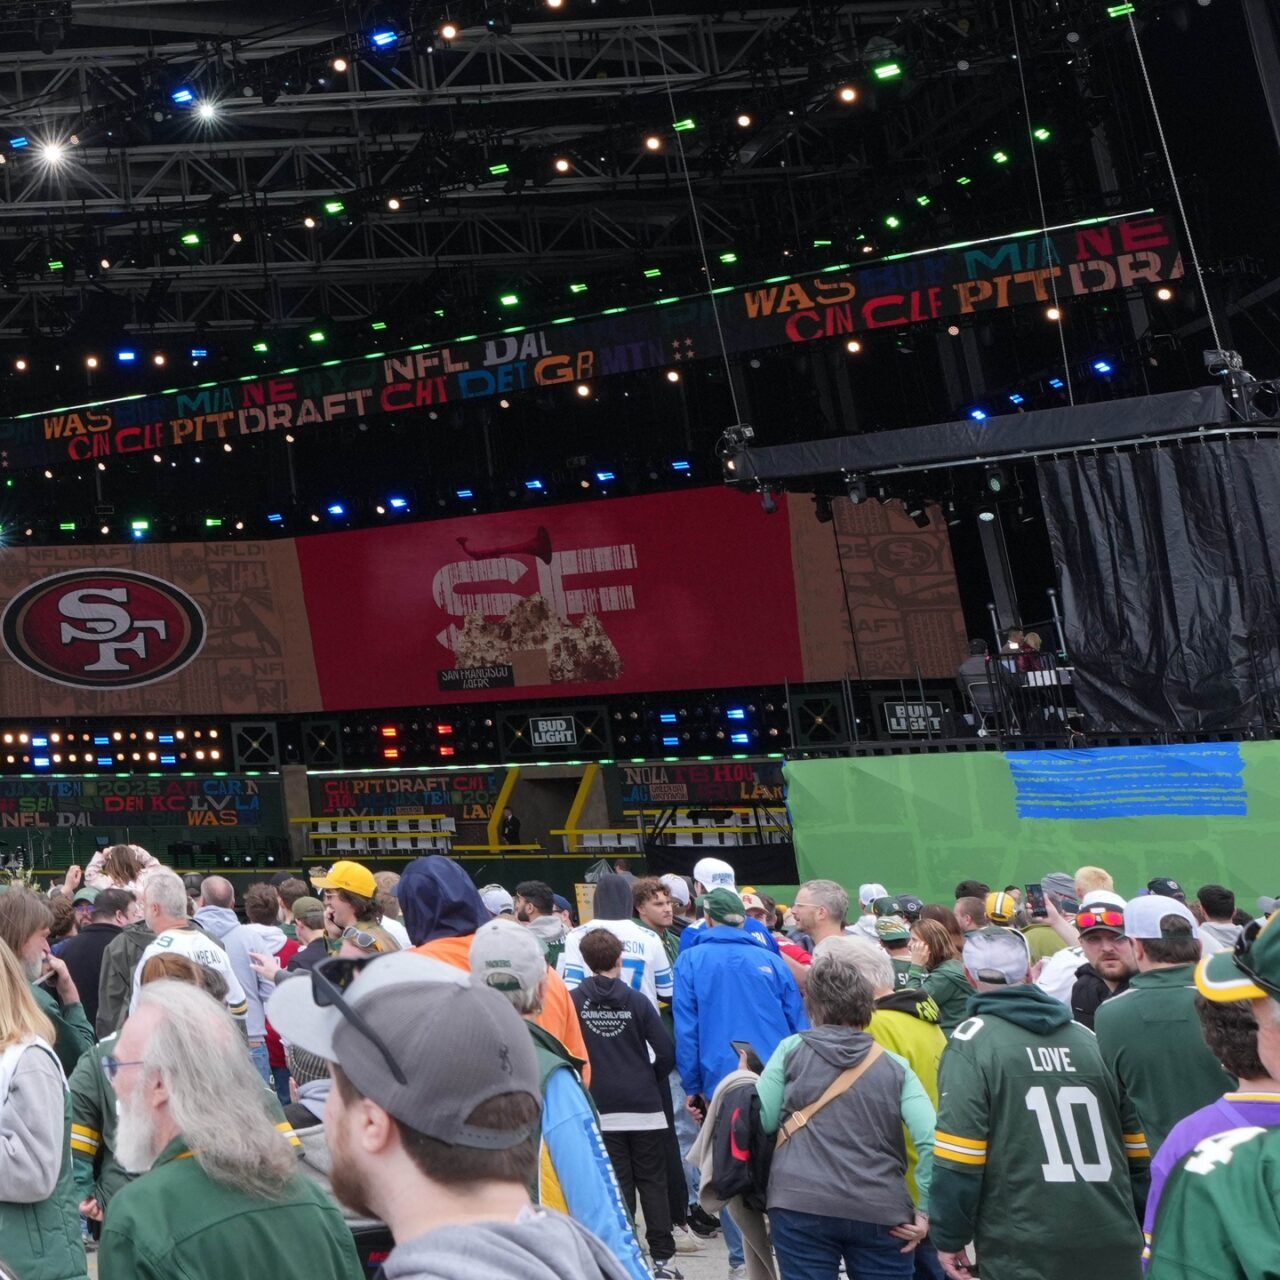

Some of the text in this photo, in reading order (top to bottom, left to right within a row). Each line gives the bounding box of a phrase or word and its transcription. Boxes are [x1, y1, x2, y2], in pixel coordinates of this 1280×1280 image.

[1075, 218, 1170, 261] NE
[744, 275, 857, 319] WAS
[953, 267, 1062, 315] PIT
[383, 331, 553, 383] NFL DAL
[458, 360, 528, 400] DET
[44, 409, 112, 440] WAS
[242, 377, 298, 407] NE
[170, 410, 235, 445] PIT
[239, 388, 373, 435] DRAFT
[442, 669, 459, 681] SAN
[534, 729, 574, 744] LIGHT
[538, 719, 566, 732] BUD
[97, 780, 161, 796] 2025
[202, 779, 241, 795] CAR
[390, 777, 450, 794] DRAFT
[625, 767, 668, 785] NOLA
[19, 797, 55, 811] SEA
[189, 794, 233, 810] LV
[1, 810, 239, 828] NFL DAL WAS
[1026, 1047, 1077, 1073] LOVE
[1025, 1086, 1113, 1183] 10
